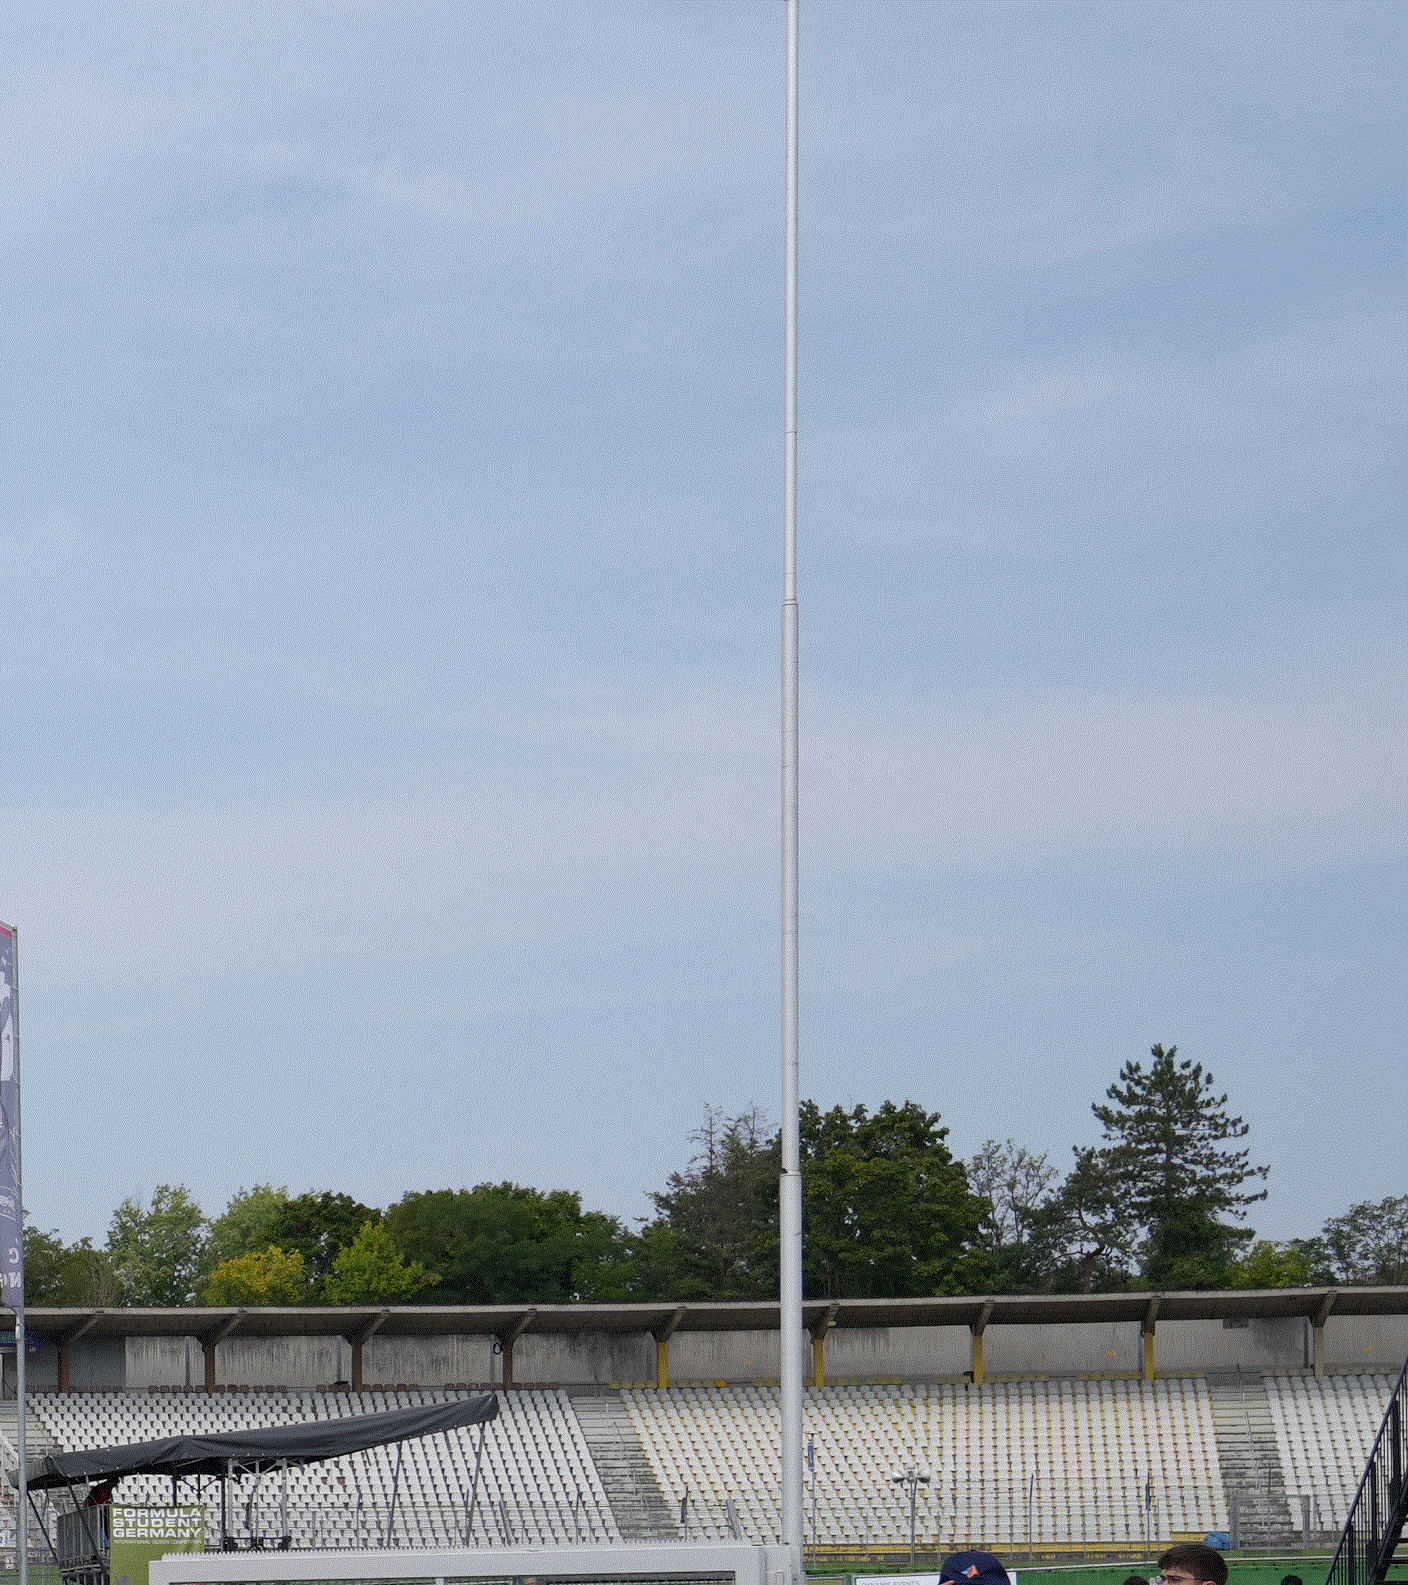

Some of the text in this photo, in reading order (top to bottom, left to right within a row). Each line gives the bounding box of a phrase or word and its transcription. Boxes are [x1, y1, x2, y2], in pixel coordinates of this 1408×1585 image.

[112, 1507, 202, 1518] FORMULA
[112, 1517, 202, 1529] STUDENT
[112, 1528, 204, 1539] GERMANY
